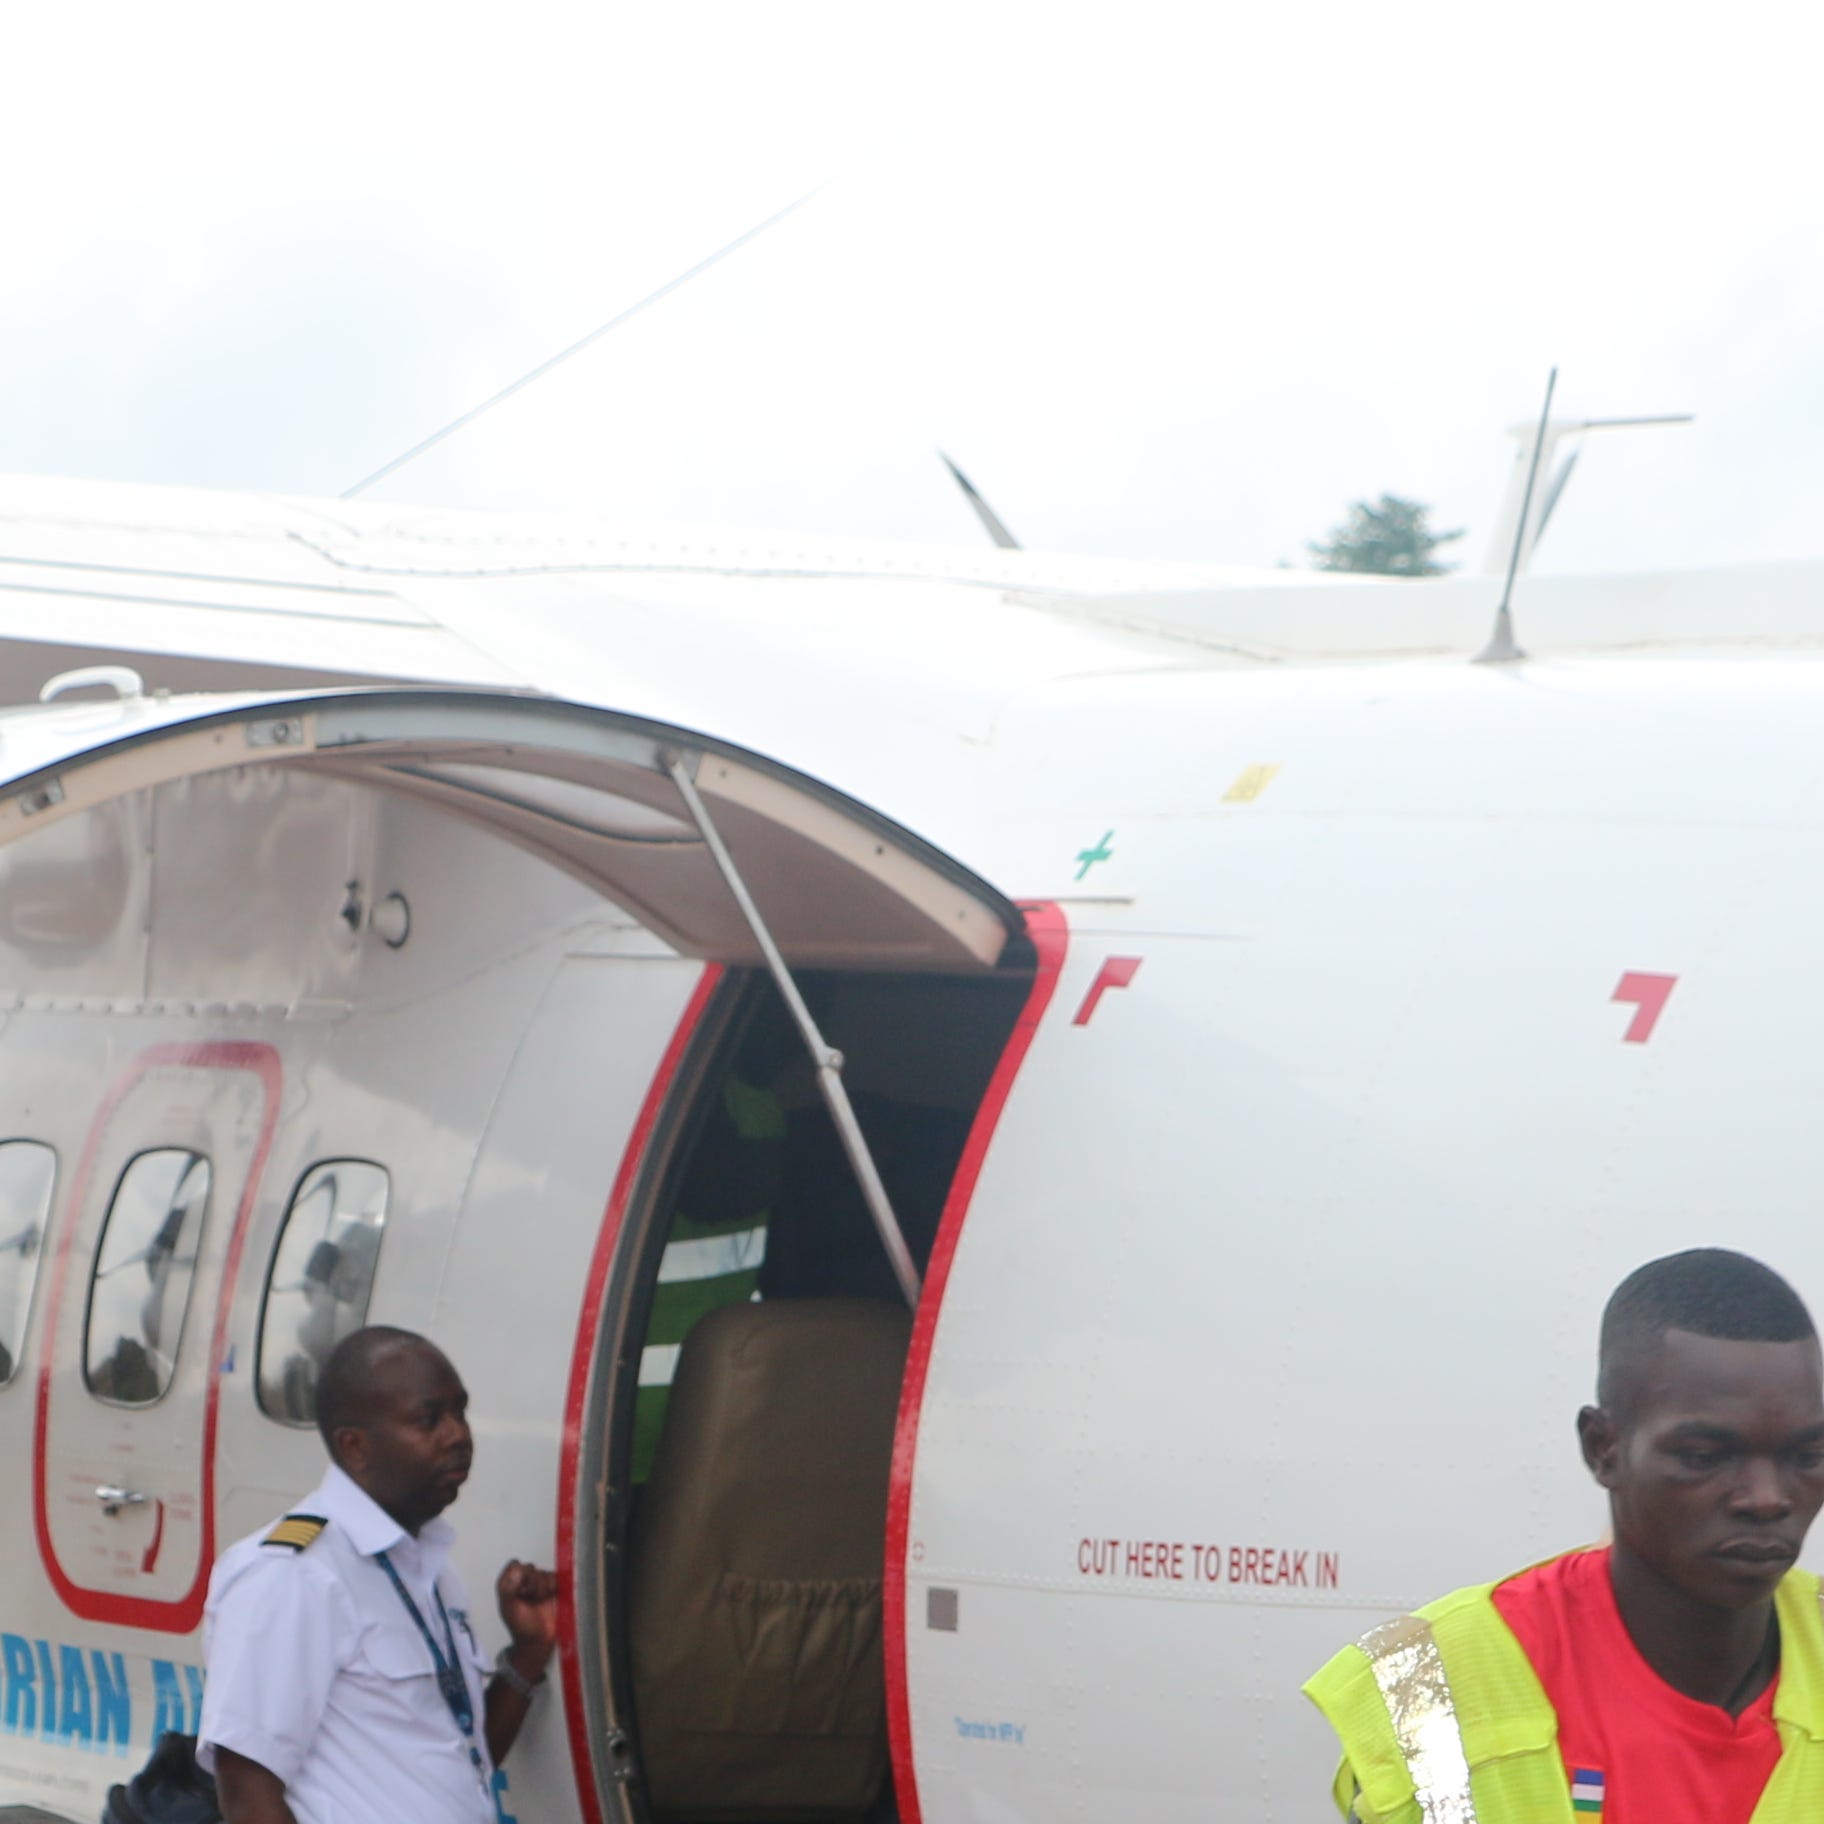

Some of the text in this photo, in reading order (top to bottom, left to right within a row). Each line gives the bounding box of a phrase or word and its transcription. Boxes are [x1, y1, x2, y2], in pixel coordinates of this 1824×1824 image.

[1077, 1538, 1340, 1589] CUT HERE TO BREAK IN
